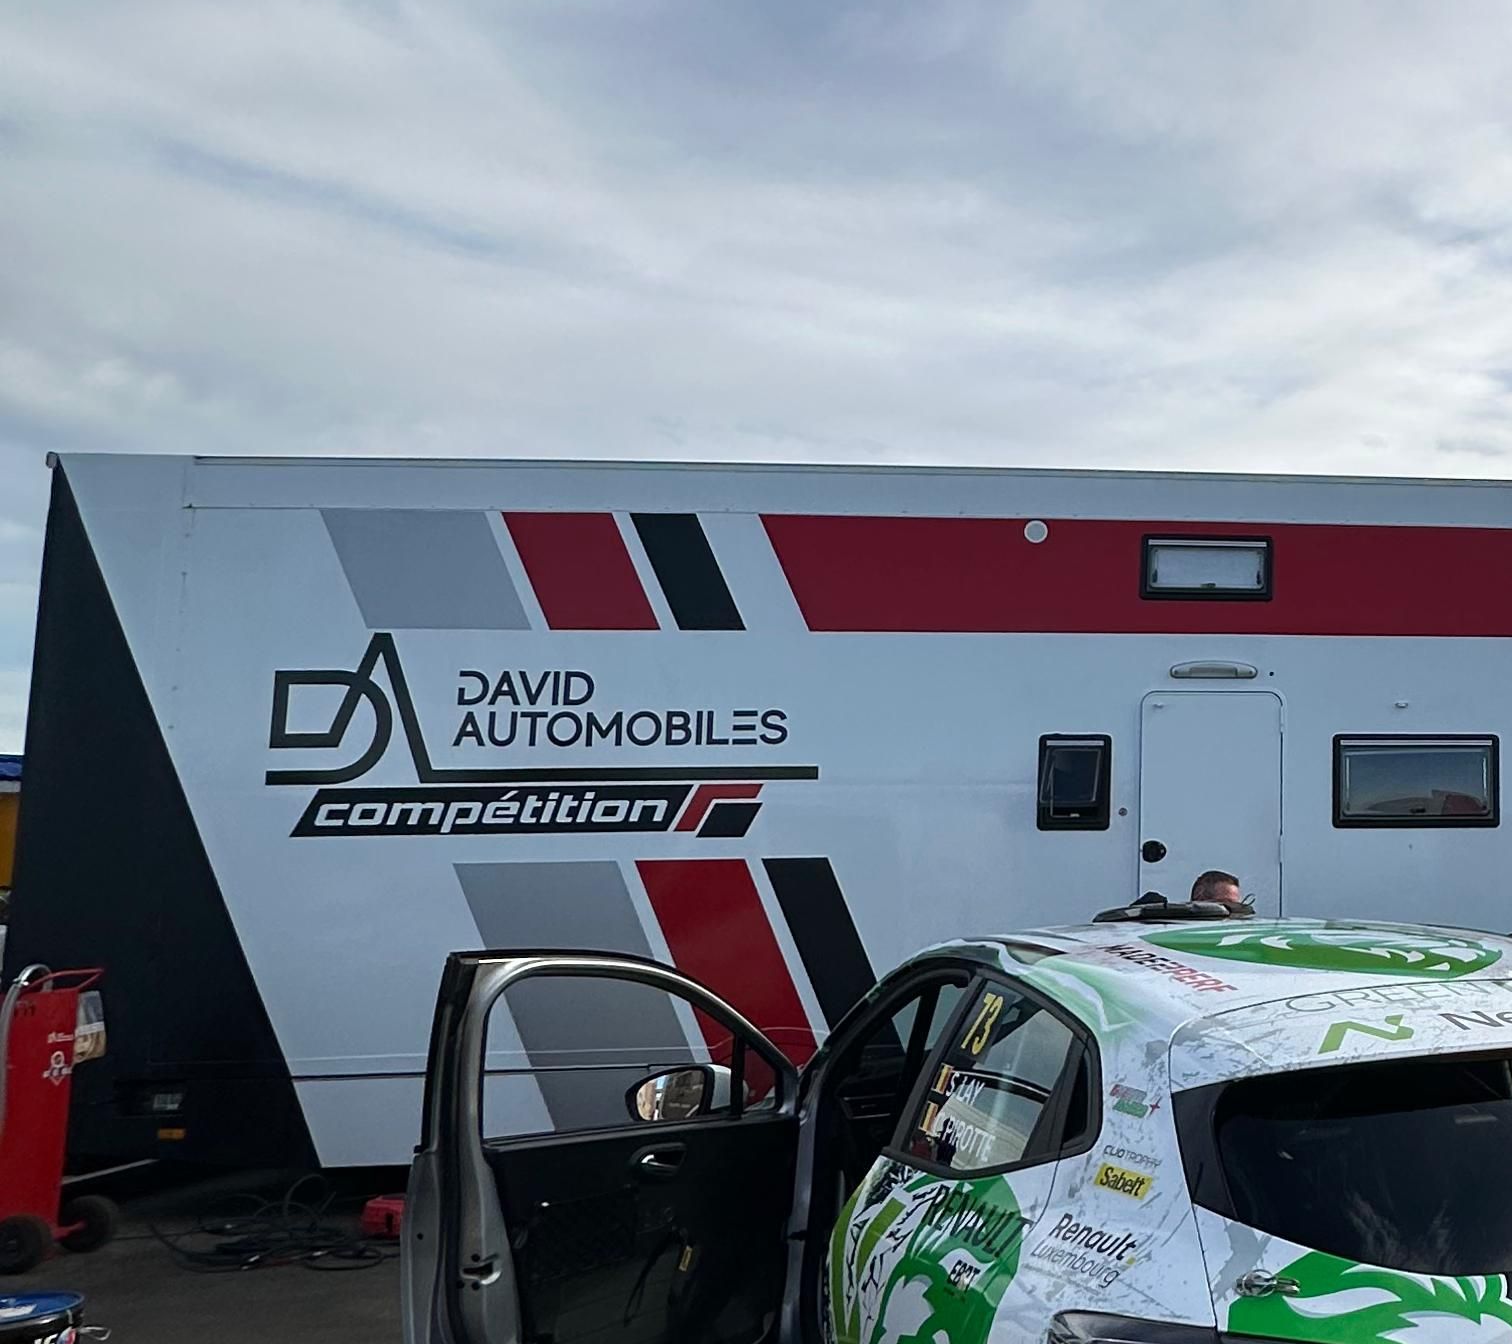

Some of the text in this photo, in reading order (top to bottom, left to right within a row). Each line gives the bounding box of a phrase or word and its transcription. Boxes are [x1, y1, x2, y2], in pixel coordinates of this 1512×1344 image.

[457, 670, 595, 706] DAVID
[452, 709, 789, 748] AUTOMOBILES
[313, 791, 668, 834] compétition
[959, 992, 1004, 1055] 73
[956, 1076, 985, 1106] LAY
[1099, 1166, 1146, 1197] Sabelt
[920, 1184, 1036, 1258] RENAULT
[1029, 1239, 1121, 1289] Luxembourg
